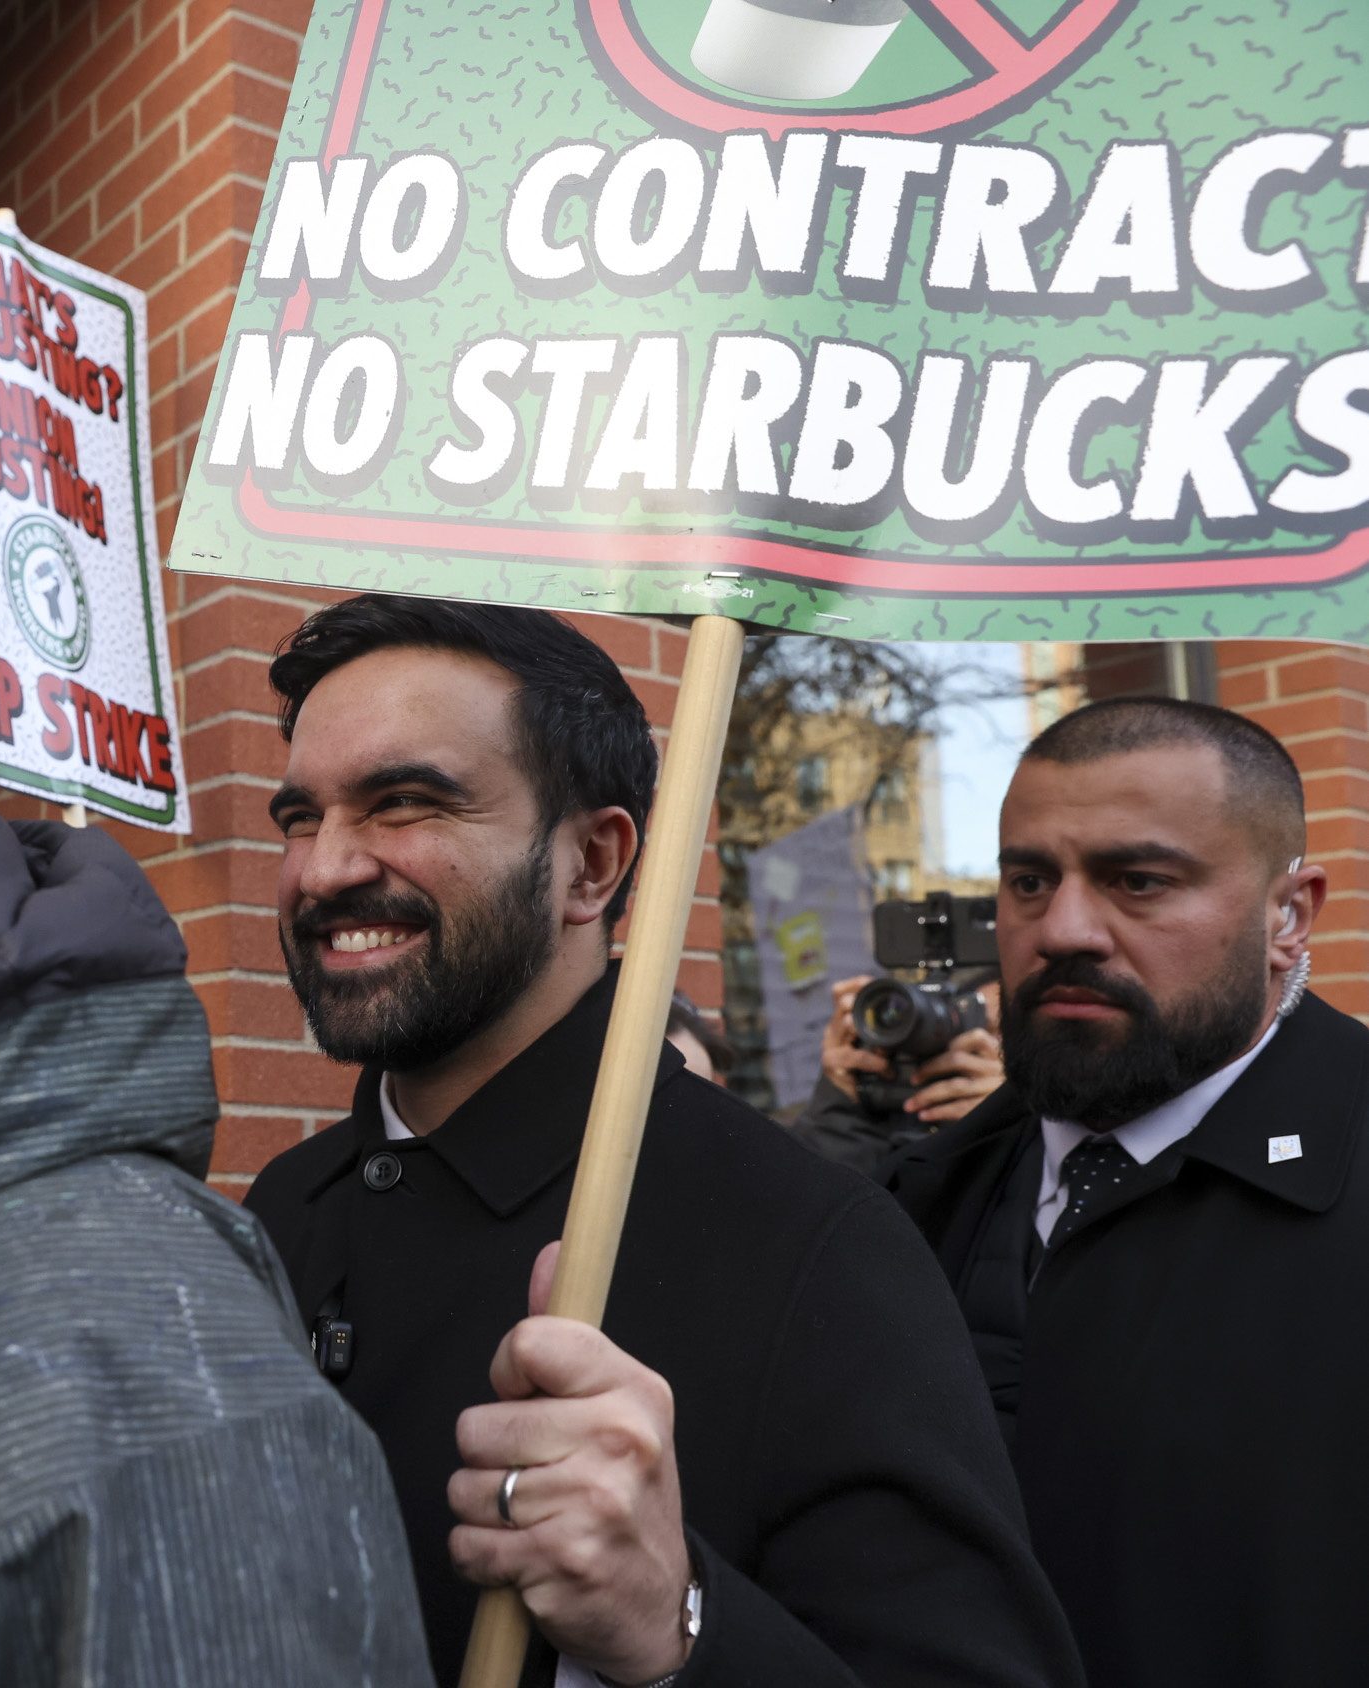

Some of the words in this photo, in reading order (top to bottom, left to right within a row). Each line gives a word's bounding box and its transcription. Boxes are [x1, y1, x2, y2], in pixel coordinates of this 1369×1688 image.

[256, 150, 465, 292] NO
[205, 332, 403, 486] NO
[428, 334, 1369, 532] STARBUCKS
[37, 672, 177, 795] STRIKE
